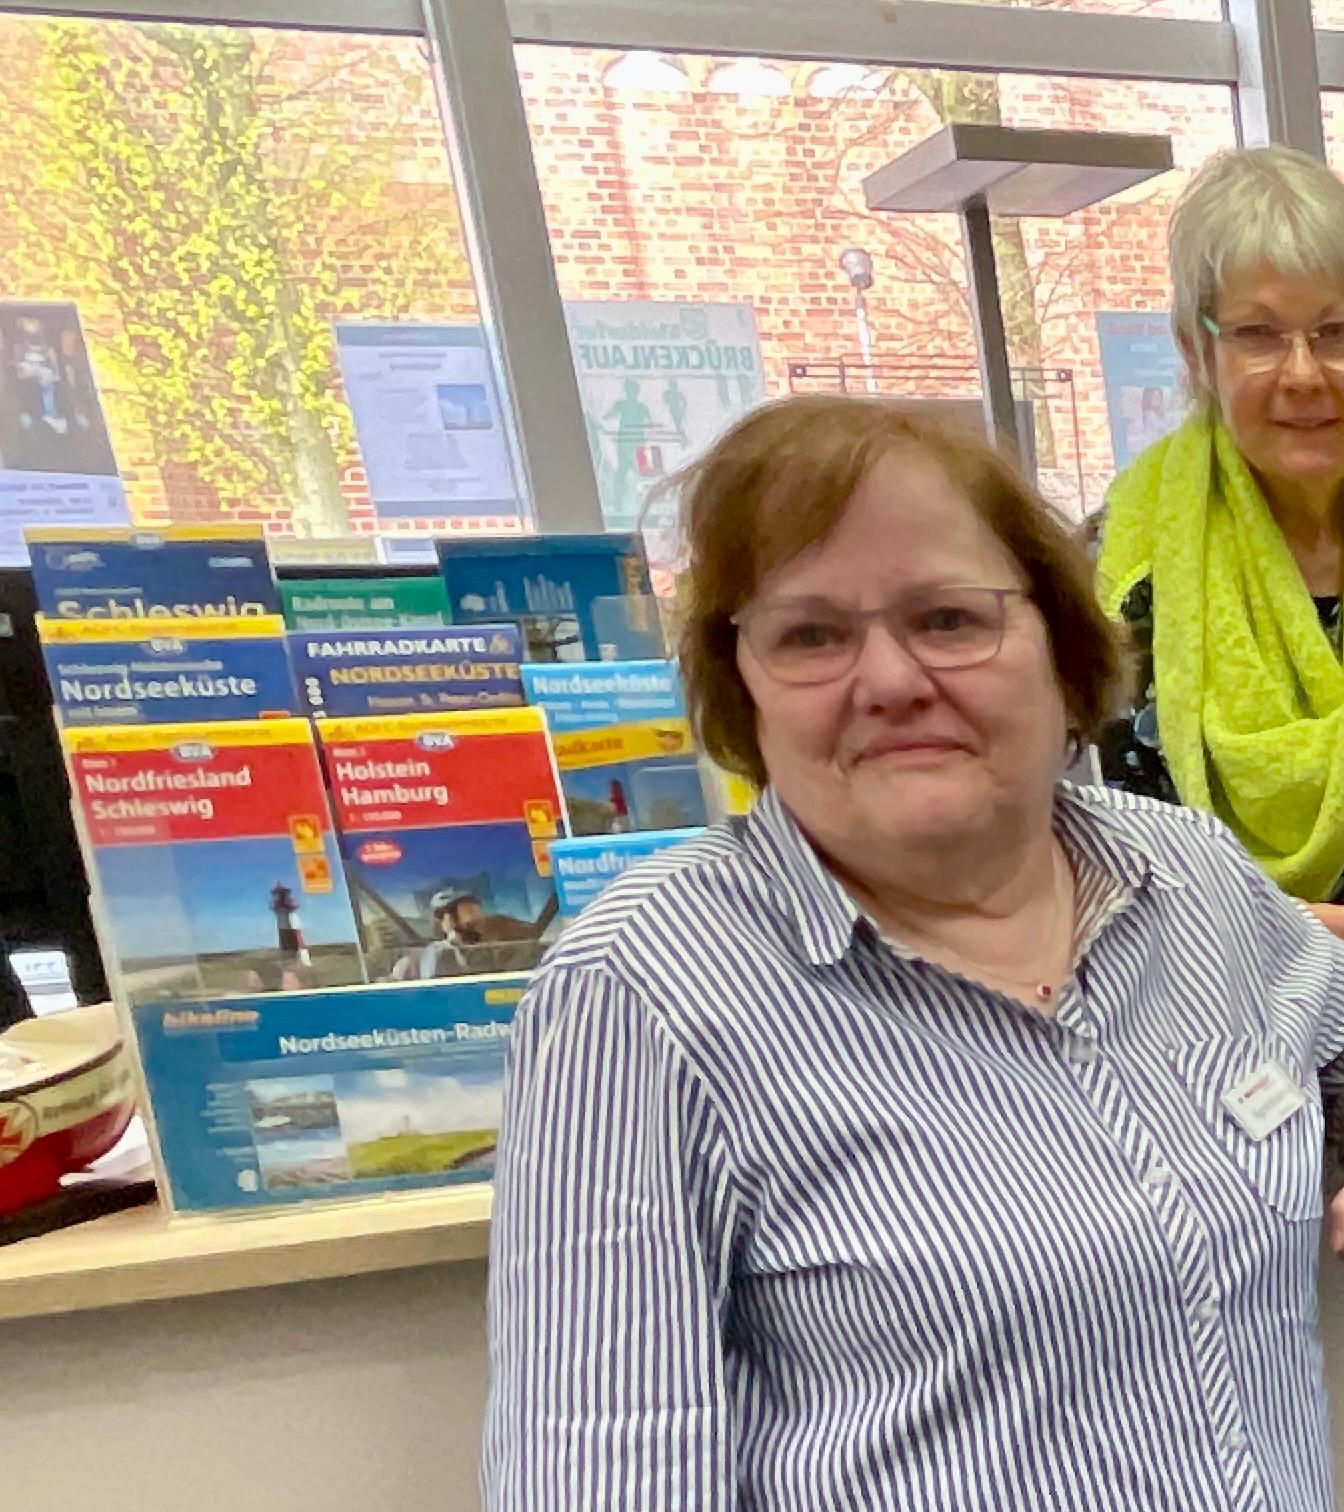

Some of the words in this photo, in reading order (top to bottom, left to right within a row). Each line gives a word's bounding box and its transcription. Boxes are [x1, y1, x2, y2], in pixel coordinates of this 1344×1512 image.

[307, 636, 486, 657] FAHRRADKARTE
[329, 660, 520, 685] NORDSEEKÜSTE
[60, 674, 257, 701] Nordseeküste
[85, 765, 251, 793] Nordfriesland
[336, 758, 431, 781] Holstein
[91, 795, 213, 819] Schleswig
[341, 784, 449, 806] Hamburg
